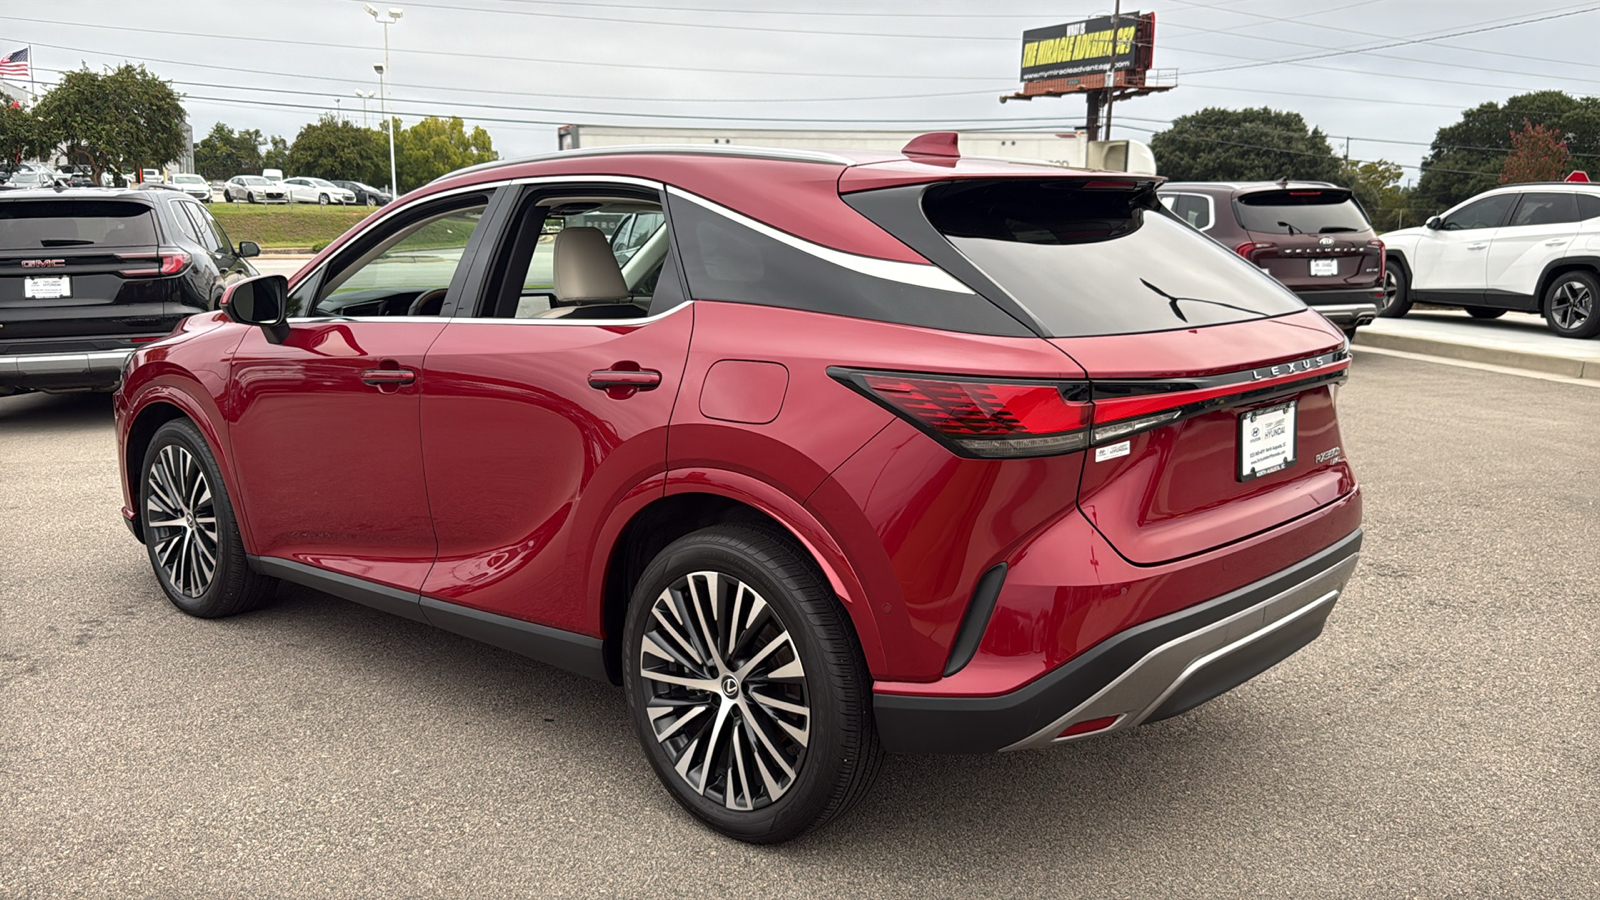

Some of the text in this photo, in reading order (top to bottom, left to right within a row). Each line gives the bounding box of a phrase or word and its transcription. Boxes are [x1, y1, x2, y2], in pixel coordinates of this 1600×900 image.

[1022, 42, 1039, 68] THE
[1036, 37, 1075, 66] MIRACLE
[21, 259, 65, 267] GMC
[1252, 357, 1324, 379] LEXUS
[1265, 426, 1285, 440] HYUNDAI
